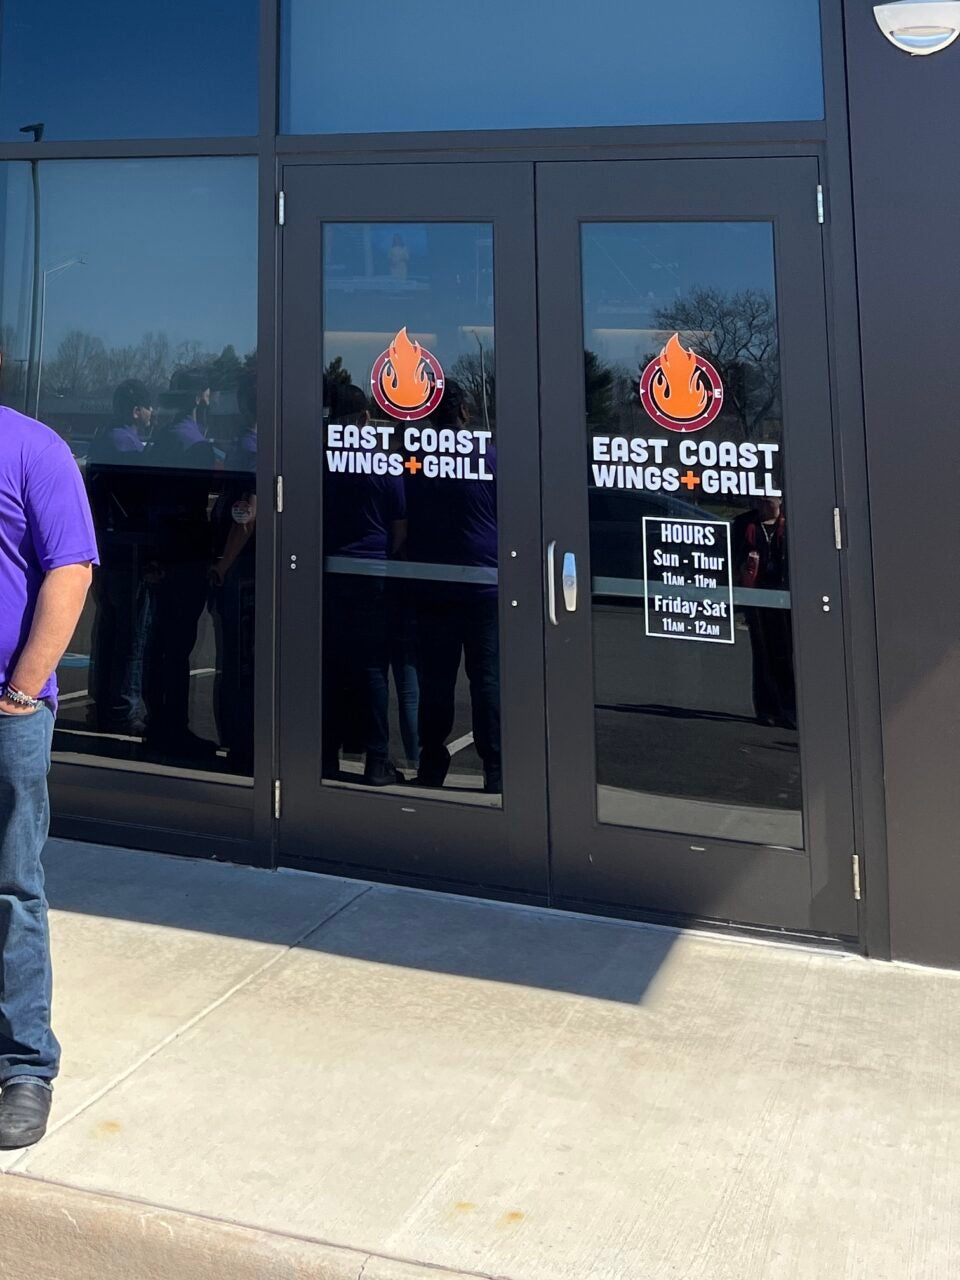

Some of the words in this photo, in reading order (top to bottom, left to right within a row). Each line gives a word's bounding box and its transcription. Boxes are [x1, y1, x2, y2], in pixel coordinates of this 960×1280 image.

[714, 389, 722, 398] E
[327, 424, 394, 450] EAST
[404, 427, 492, 455] COAST
[592, 436, 668, 464] EAST
[679, 440, 779, 469] COAST
[661, 523, 715, 546] HOURS
[653, 549, 679, 567] Sun
[691, 552, 725, 570] Thur
[662, 572, 685, 586] 11AM
[694, 574, 717, 589] 11PM
[654, 595, 727, 618] Friday-Sat
[662, 618, 685, 632] 11AM
[694, 621, 720, 636] 12AM
